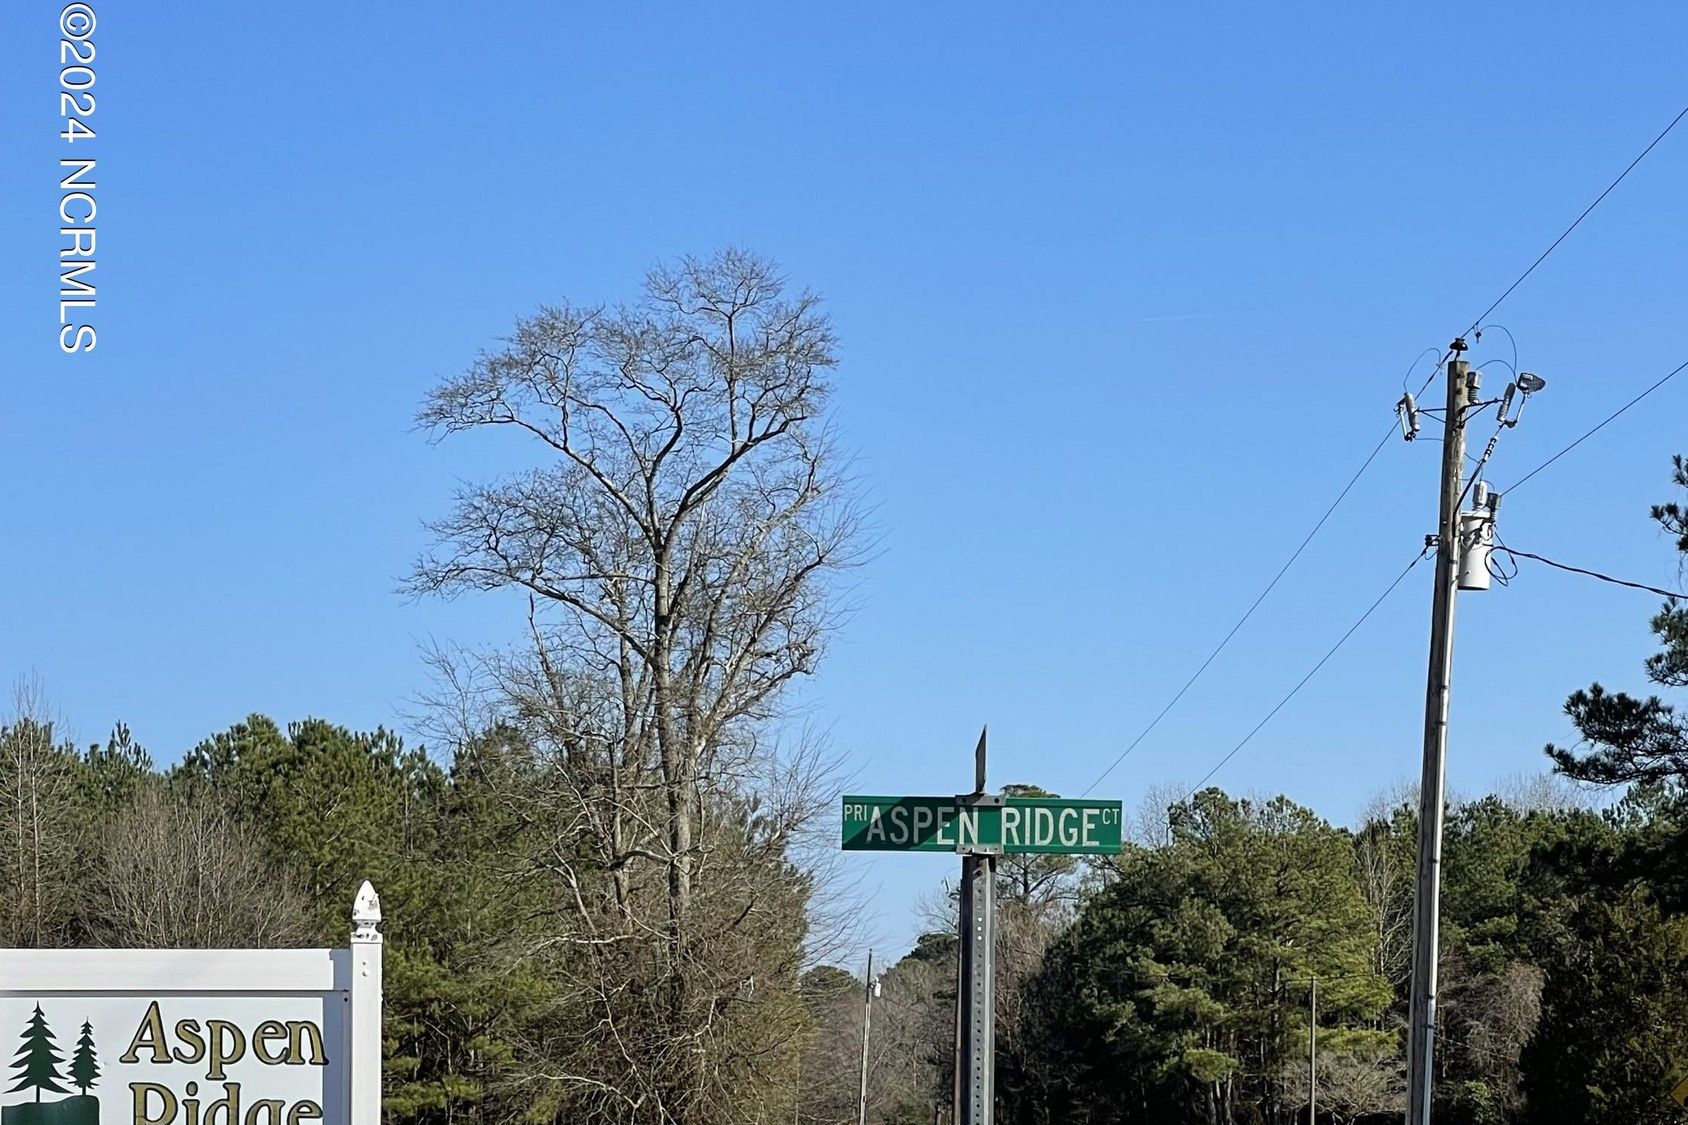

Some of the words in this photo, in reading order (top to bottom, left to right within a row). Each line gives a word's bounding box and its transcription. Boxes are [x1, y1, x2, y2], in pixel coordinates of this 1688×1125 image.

[844, 804, 867, 822] PRI
[866, 806, 979, 845] ASPEN
[1001, 807, 1100, 846] RIDGE
[1102, 810, 1119, 825] CT
[120, 1000, 329, 1080] Aspen
